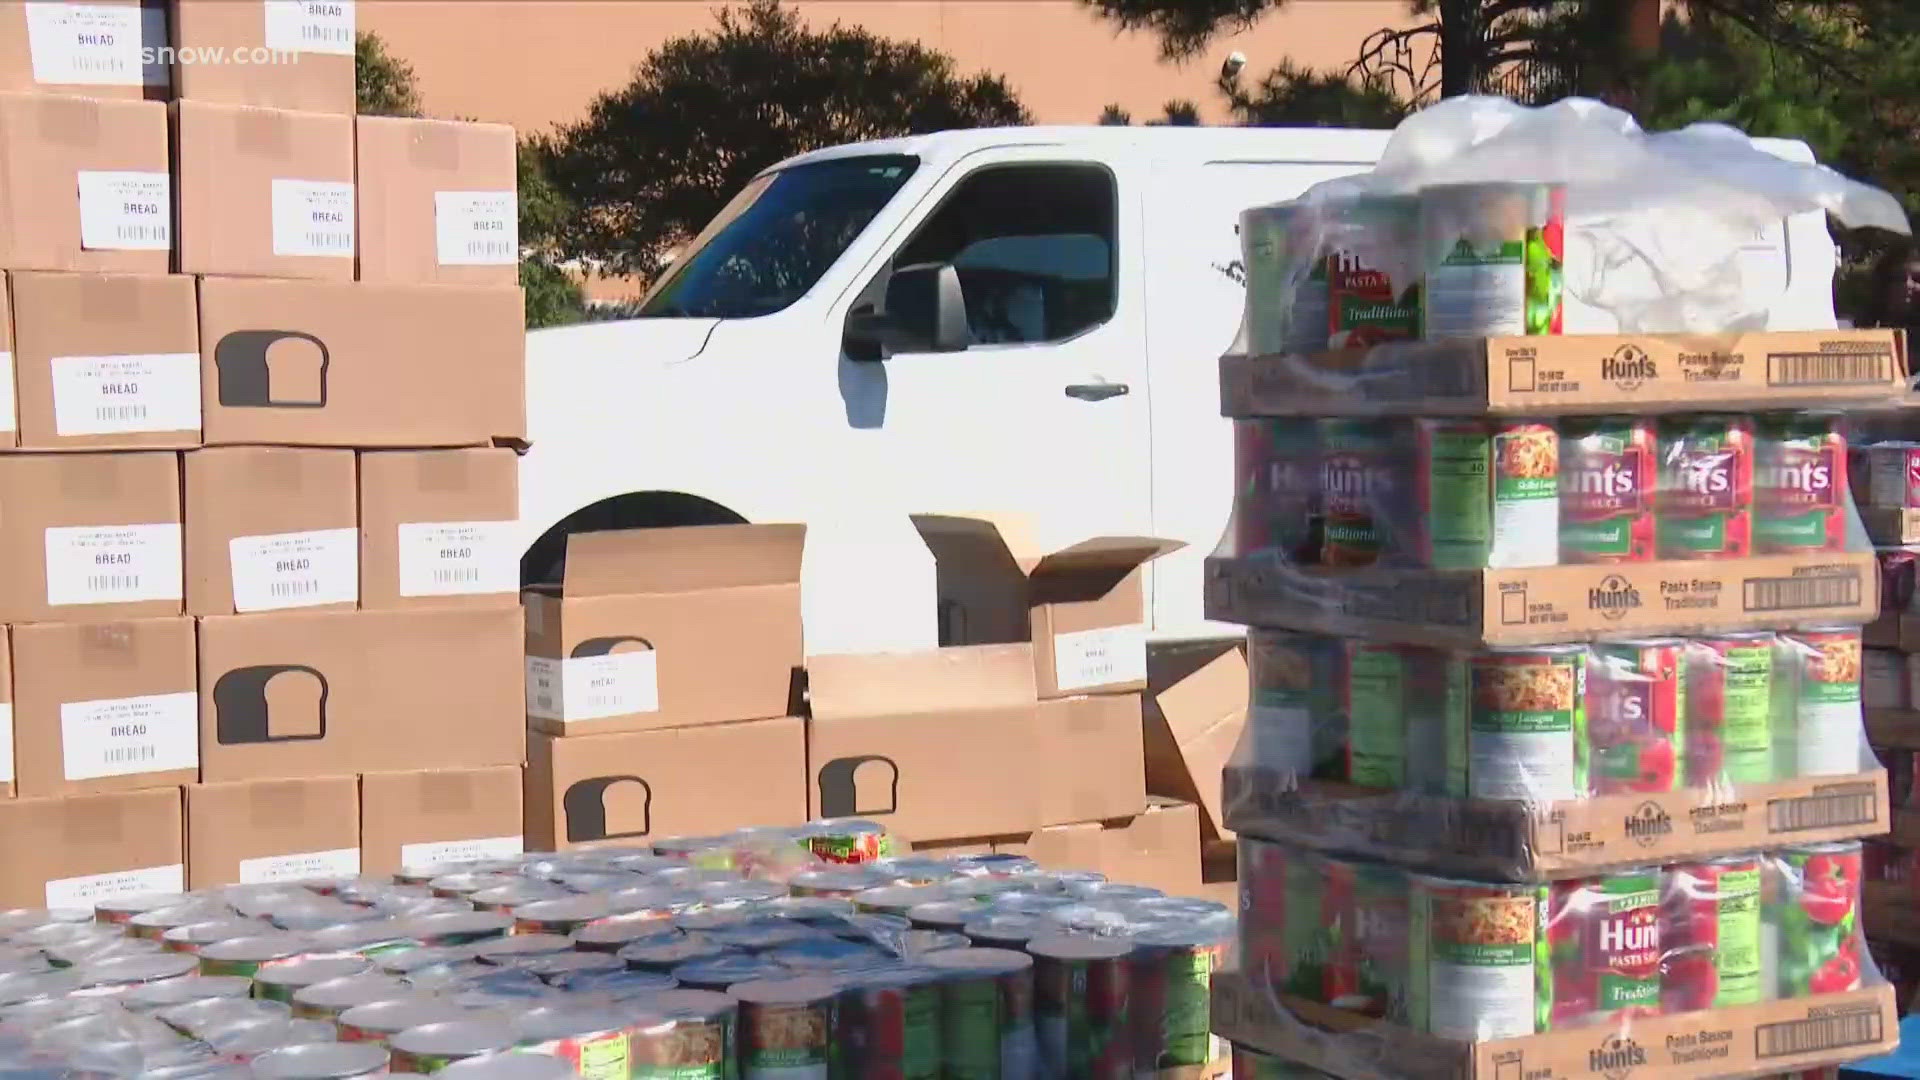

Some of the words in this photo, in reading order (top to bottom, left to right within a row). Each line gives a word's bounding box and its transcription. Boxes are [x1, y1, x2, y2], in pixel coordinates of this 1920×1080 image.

[308, 4, 342, 16] BREAD
[78, 33, 114, 46] BREAD
[123, 203, 158, 215] BREAD
[312, 211, 343, 223] BREAD
[474, 220, 503, 231] BREAD
[1602, 354, 1657, 381] Hunt's
[102, 382, 138, 395] BREAD
[95, 552, 131, 565] BREAD
[440, 547, 472, 559] BREAD
[276, 558, 310, 573] BREAD
[1660, 580, 1689, 594] Pasta
[1588, 584, 1642, 610] Hunt's
[1664, 596, 1718, 611] Traditional
[591, 677, 617, 689] BREAD
[111, 724, 147, 737] BREAD
[1624, 809, 1673, 839] Hunt's
[1609, 954, 1642, 967] PASTA
[1666, 1034, 1697, 1048] Pasta
[1699, 1029, 1733, 1042] Sauce
[1589, 1038, 1647, 1072] Hunt's
[1671, 1045, 1728, 1064] Traditional
